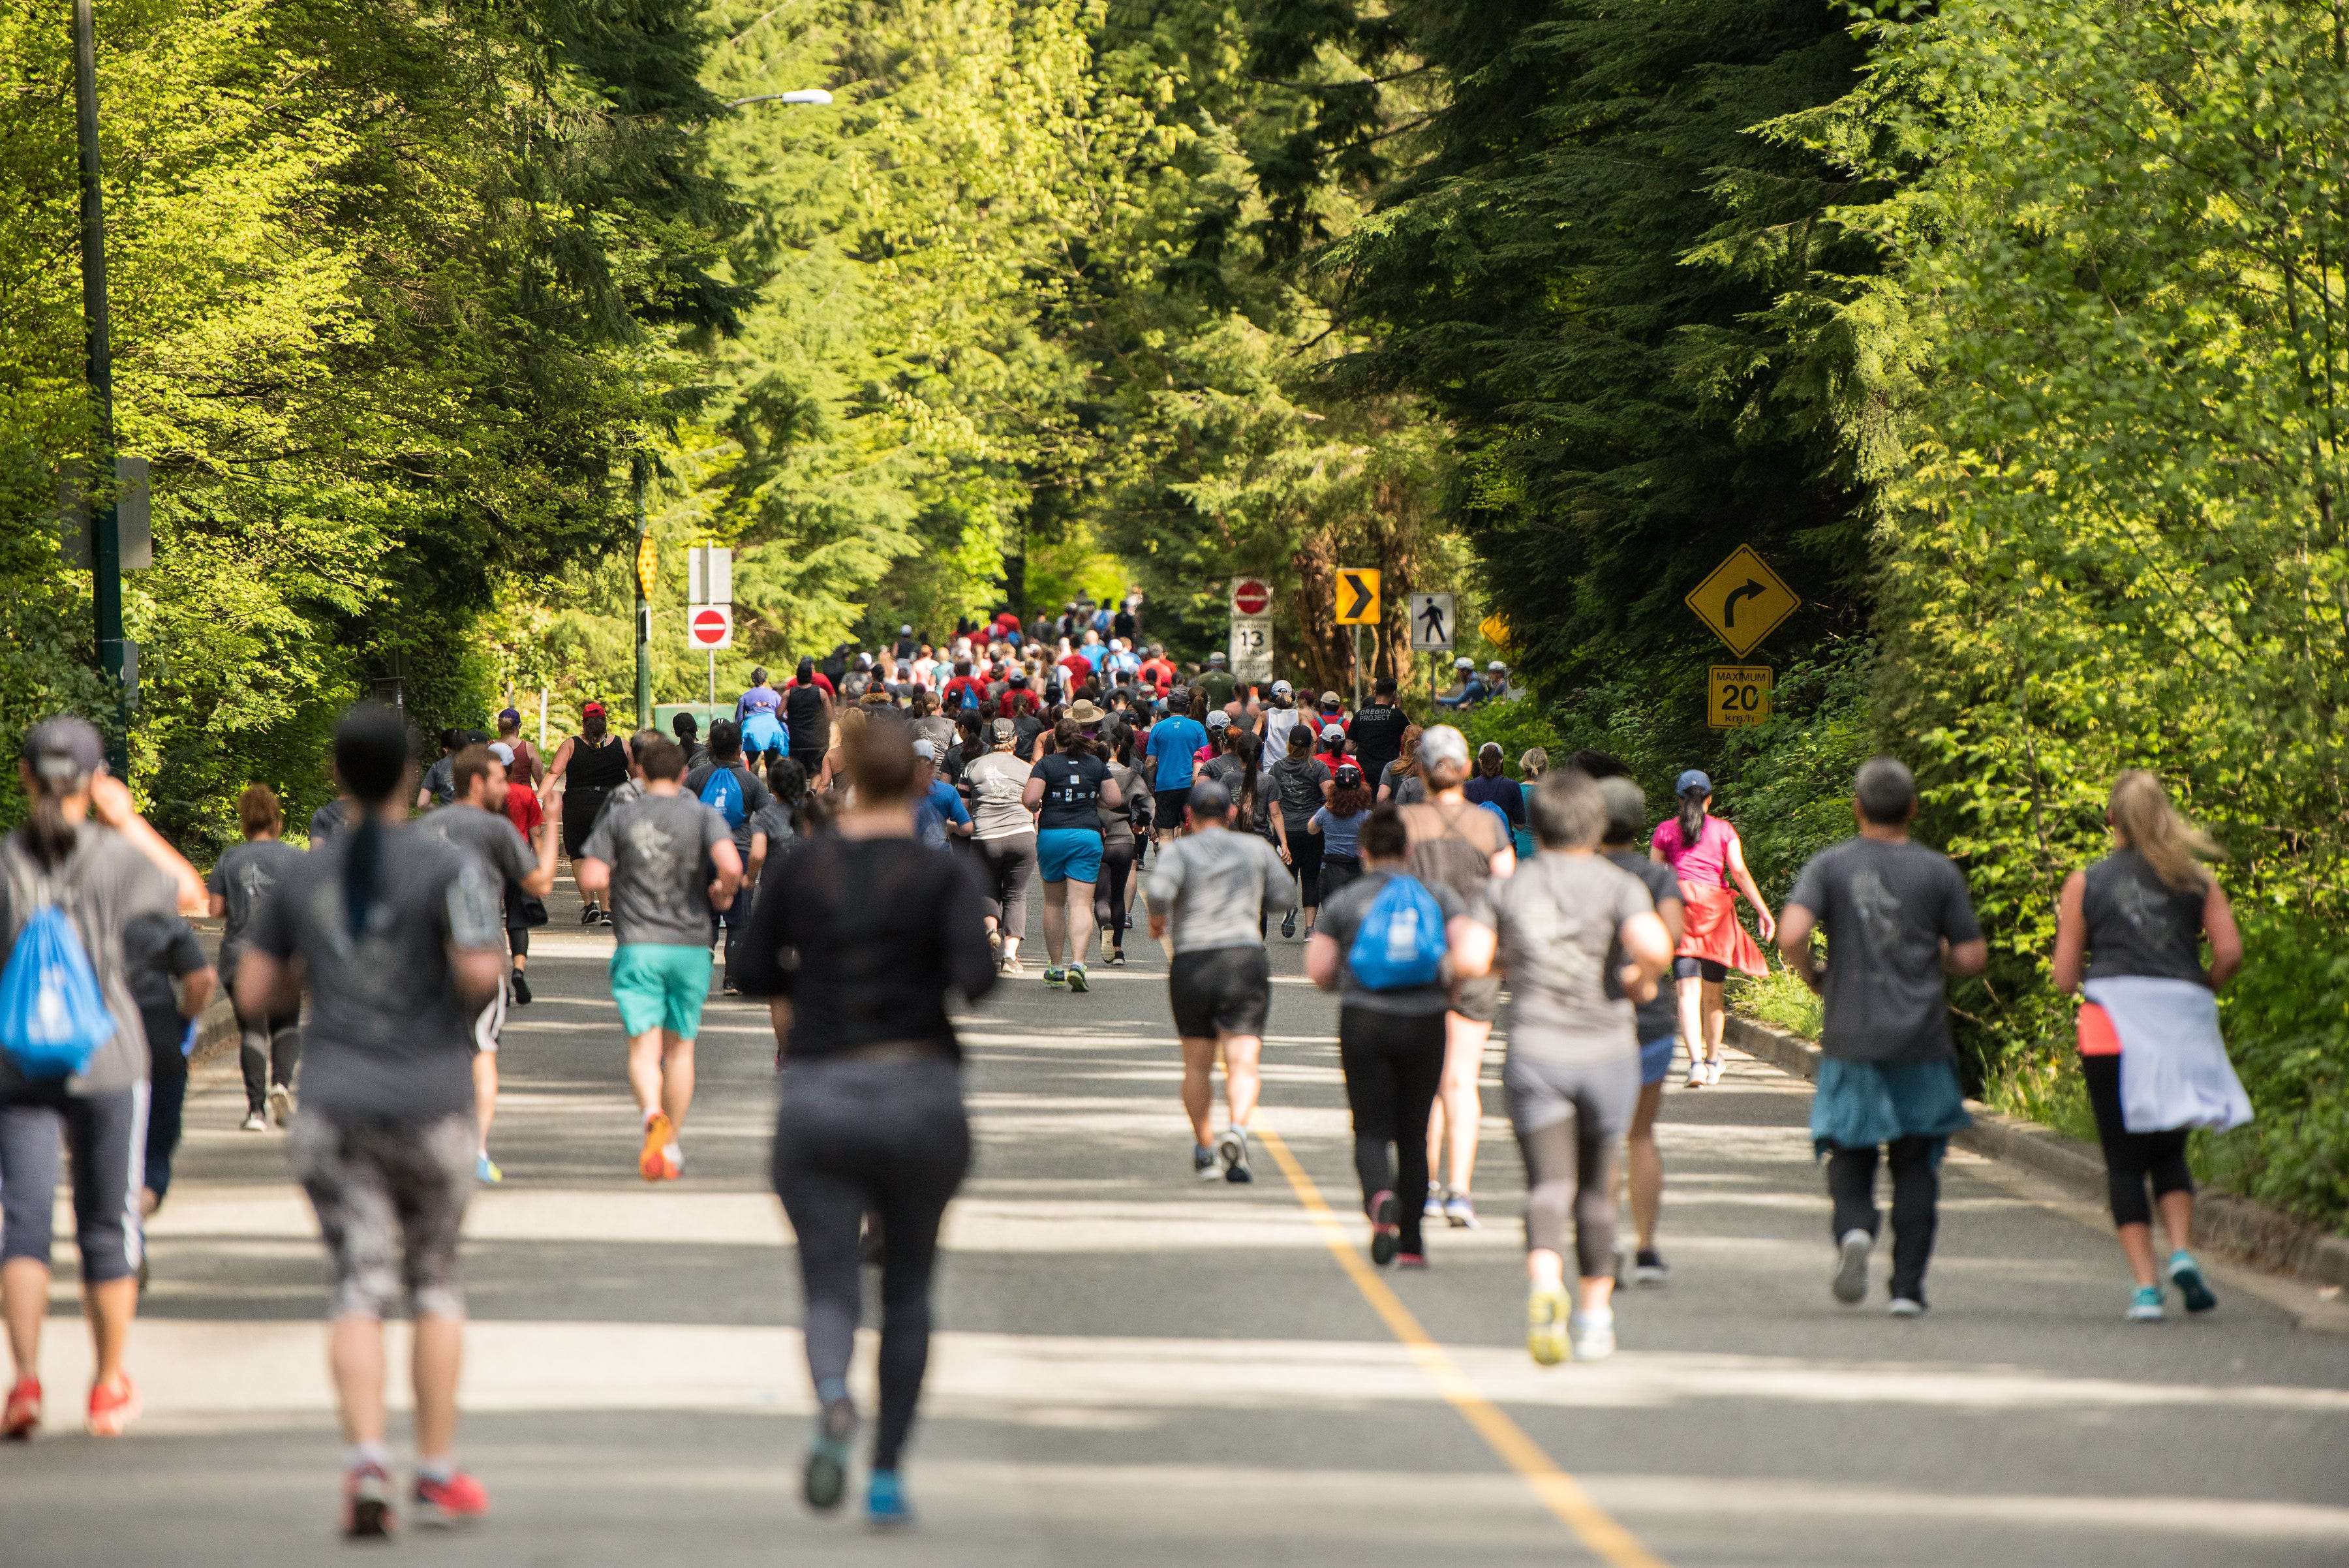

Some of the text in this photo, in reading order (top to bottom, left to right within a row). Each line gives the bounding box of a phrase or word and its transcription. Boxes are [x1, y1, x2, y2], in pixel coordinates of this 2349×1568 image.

[1242, 630, 1264, 646] 13
[1717, 672, 1766, 681] MAXIMUM
[1721, 684, 1759, 711] 20
[1725, 714, 1755, 722] km/h
